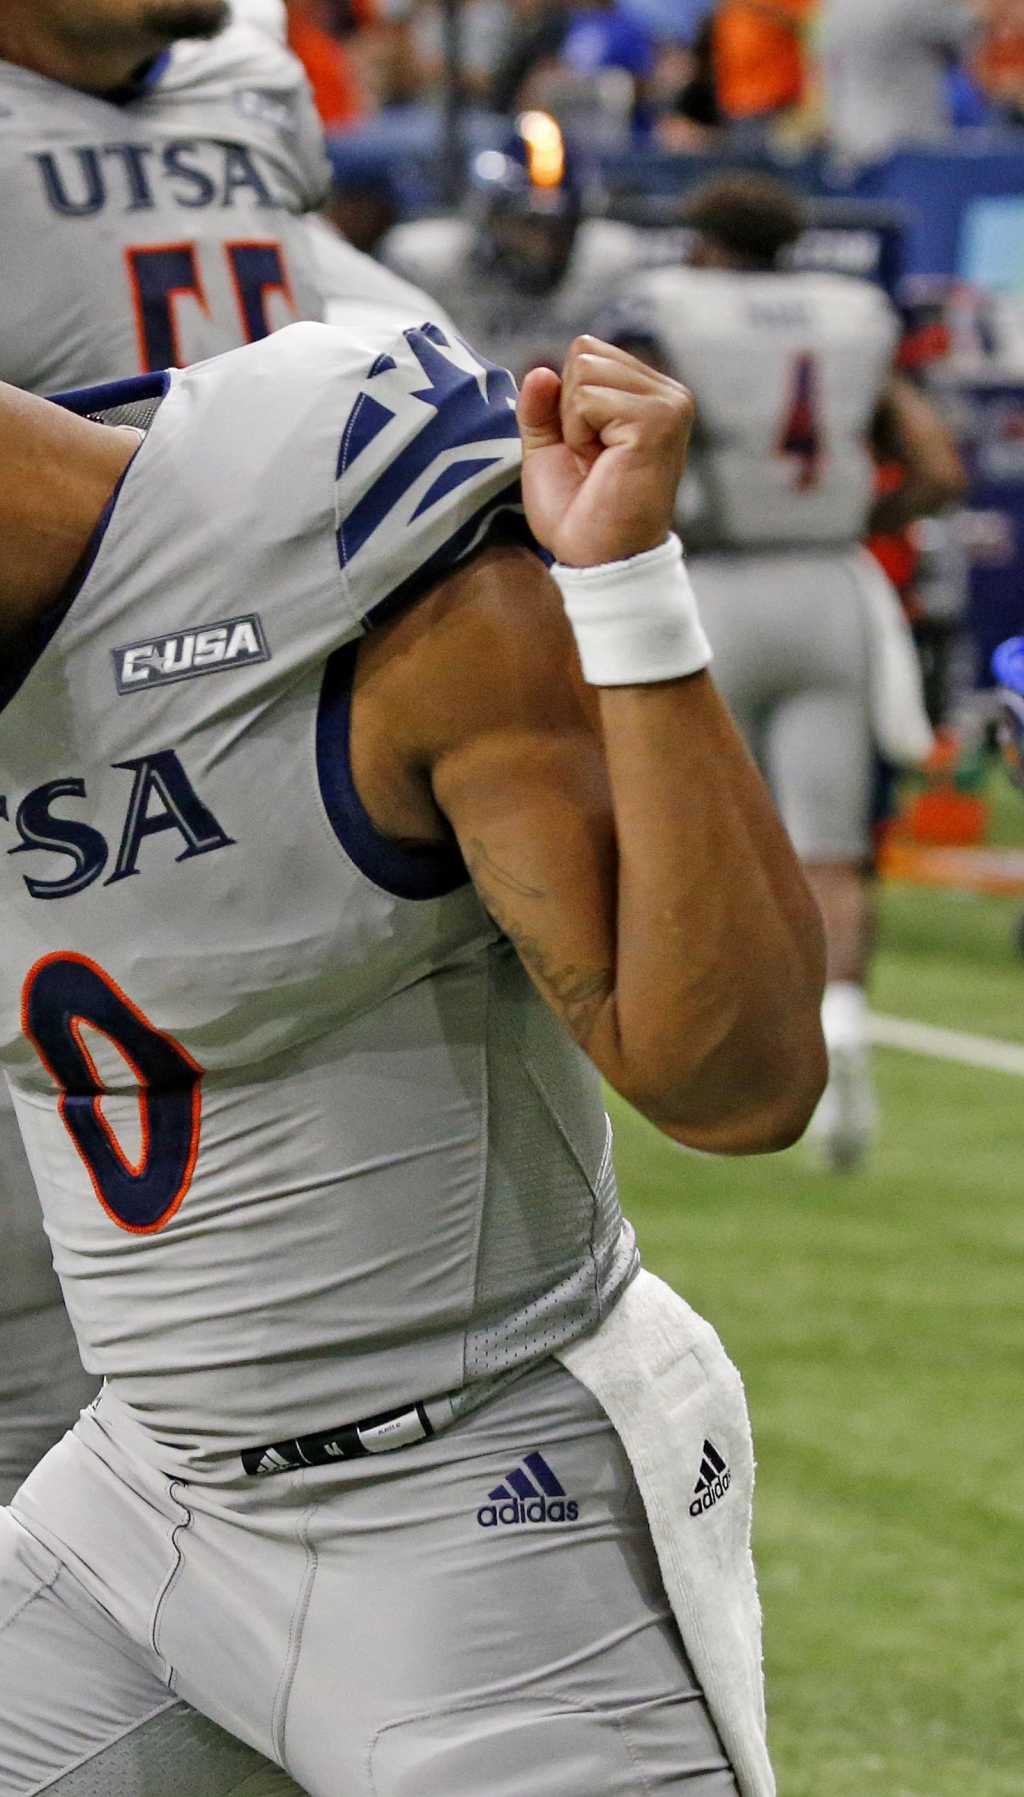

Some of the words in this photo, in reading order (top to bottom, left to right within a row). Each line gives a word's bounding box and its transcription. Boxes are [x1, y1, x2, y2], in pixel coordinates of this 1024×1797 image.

[33, 140, 287, 216] UTSA
[20, 950, 205, 1235] 0
[477, 1496, 579, 1527] adidas
